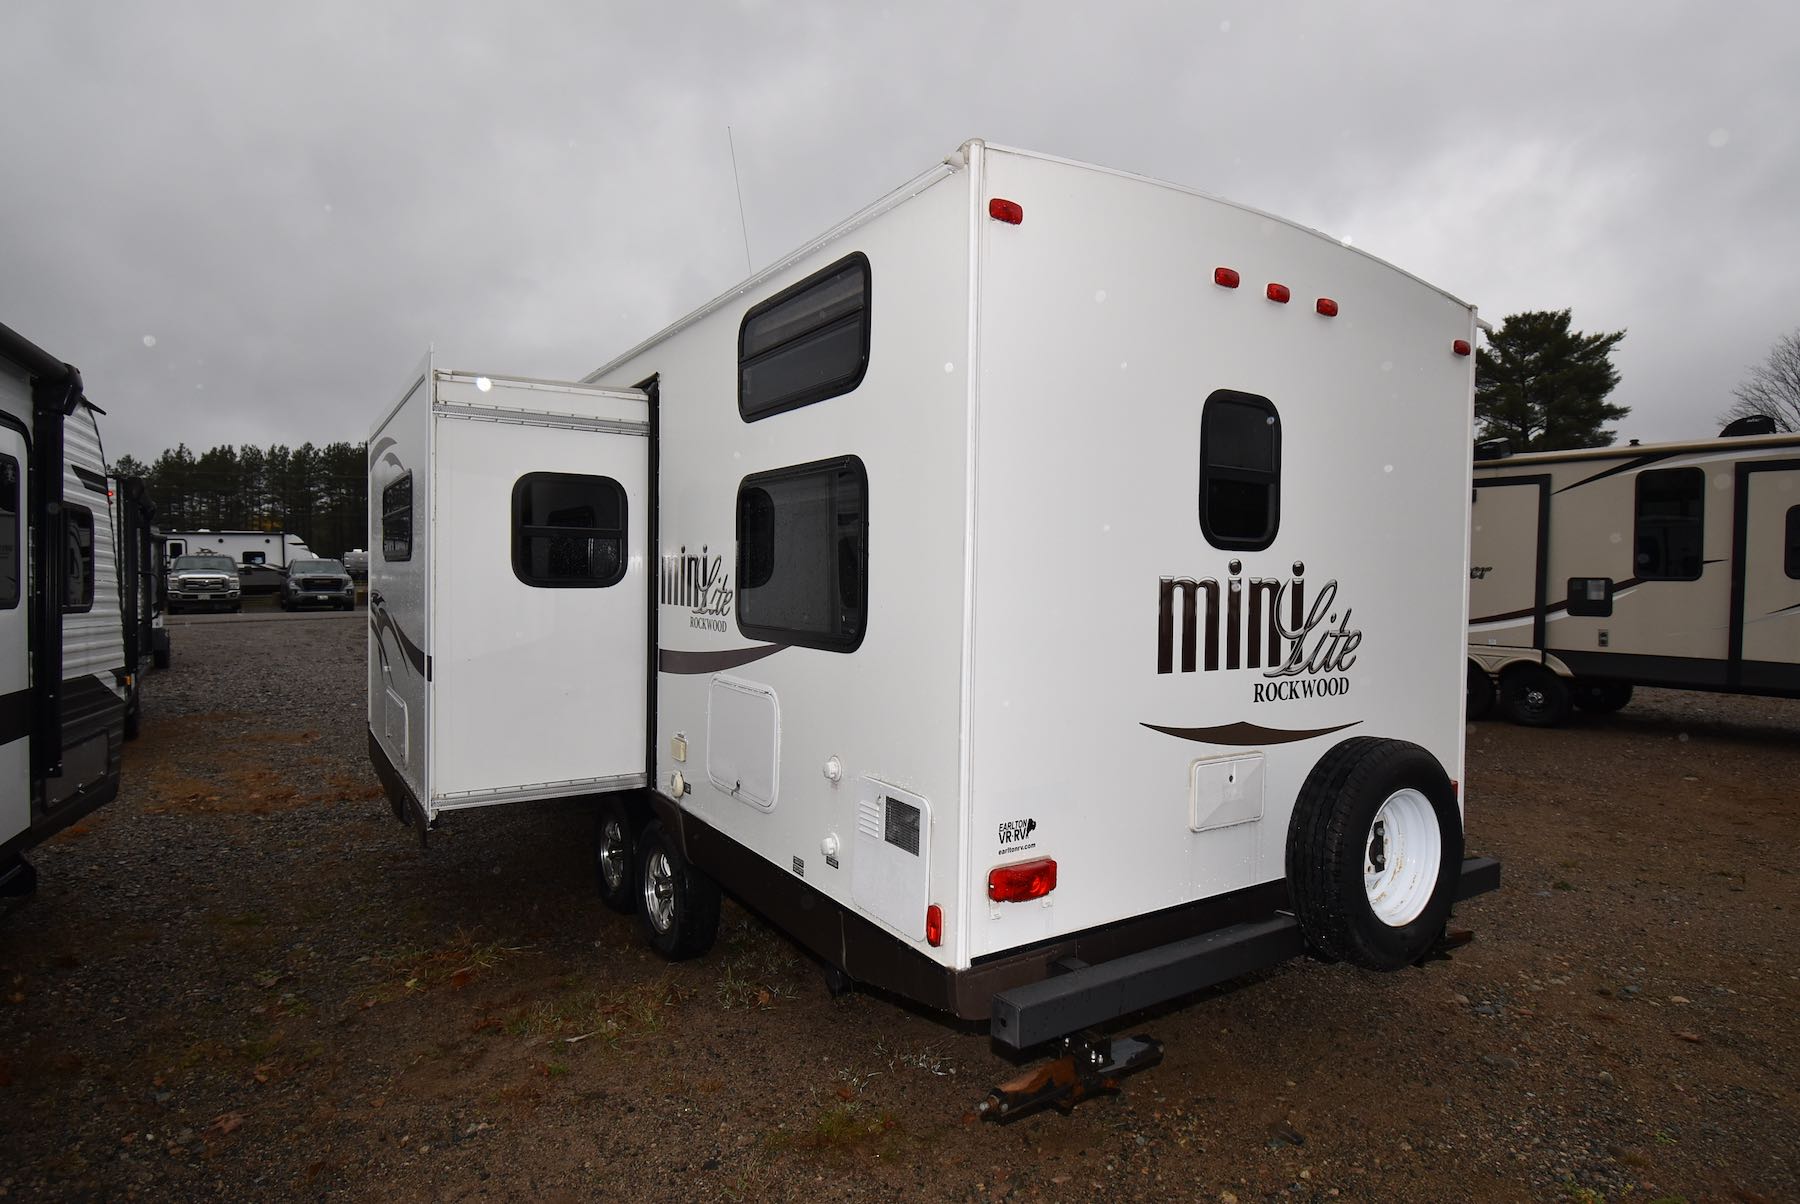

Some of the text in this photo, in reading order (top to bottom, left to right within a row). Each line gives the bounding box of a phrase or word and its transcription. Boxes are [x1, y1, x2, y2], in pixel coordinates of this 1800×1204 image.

[661, 544, 708, 608] mini
[690, 617, 728, 633] ROCKWOOD
[1158, 558, 1305, 674] mini
[1253, 677, 1350, 703] ROCKWOOD
[998, 819, 1027, 832] EARLTON
[998, 843, 1036, 855] earltonrv.com
